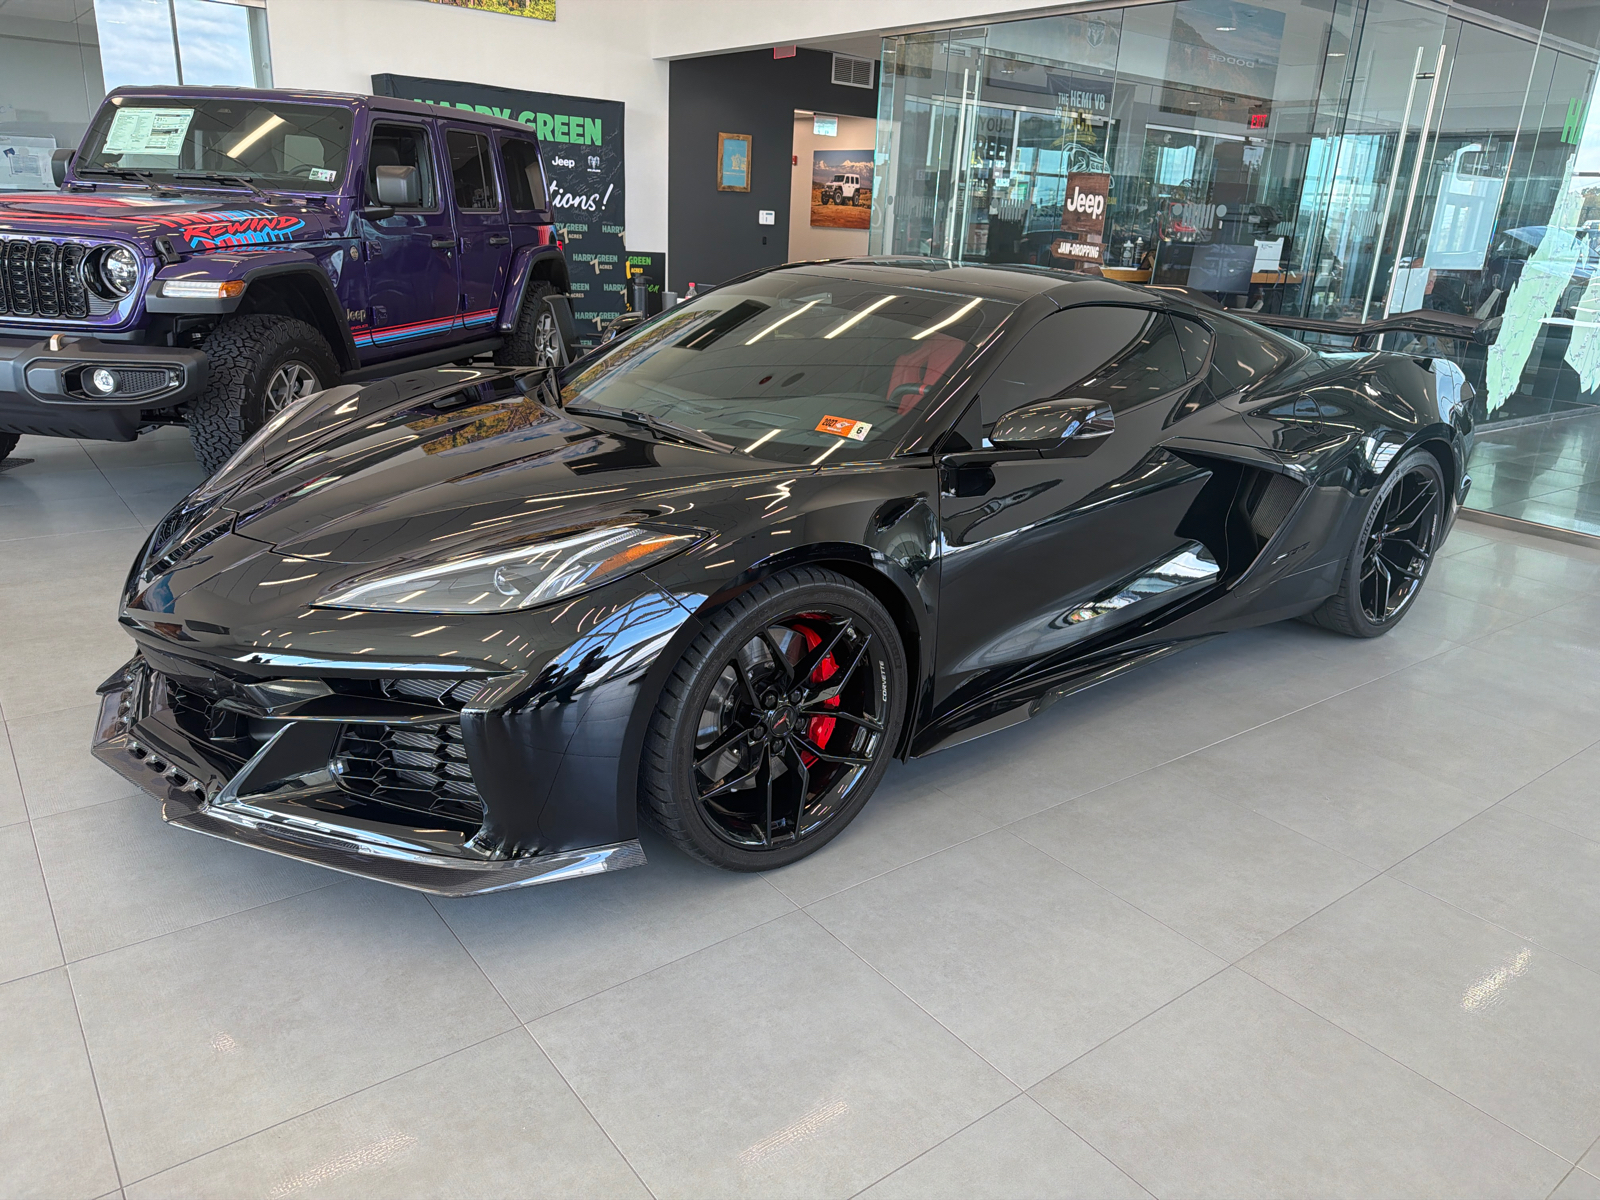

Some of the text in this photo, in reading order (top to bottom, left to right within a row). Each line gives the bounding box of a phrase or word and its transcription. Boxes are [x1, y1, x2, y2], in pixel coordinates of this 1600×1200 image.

[1058, 90, 1106, 110] THE HEMI V8
[517, 110, 602, 146] GREEN
[1250, 114, 1267, 129] EXIT
[551, 156, 575, 169] Jeep
[1067, 186, 1104, 220] Jeep
[182, 216, 300, 242] REWIND
[566, 223, 588, 232] GREEN
[601, 224, 624, 234] HARRY
[1058, 241, 1100, 259] JAW-DROPPING
[572, 253, 618, 263] HARRY GREEN
[628, 255, 652, 266] GREEN
[603, 283, 626, 291] HARRY
[346, 308, 366, 322] Jeep
[575, 312, 598, 320] HARRY
[856, 426, 864, 434] 6
[879, 660, 887, 702] CORVETTE
